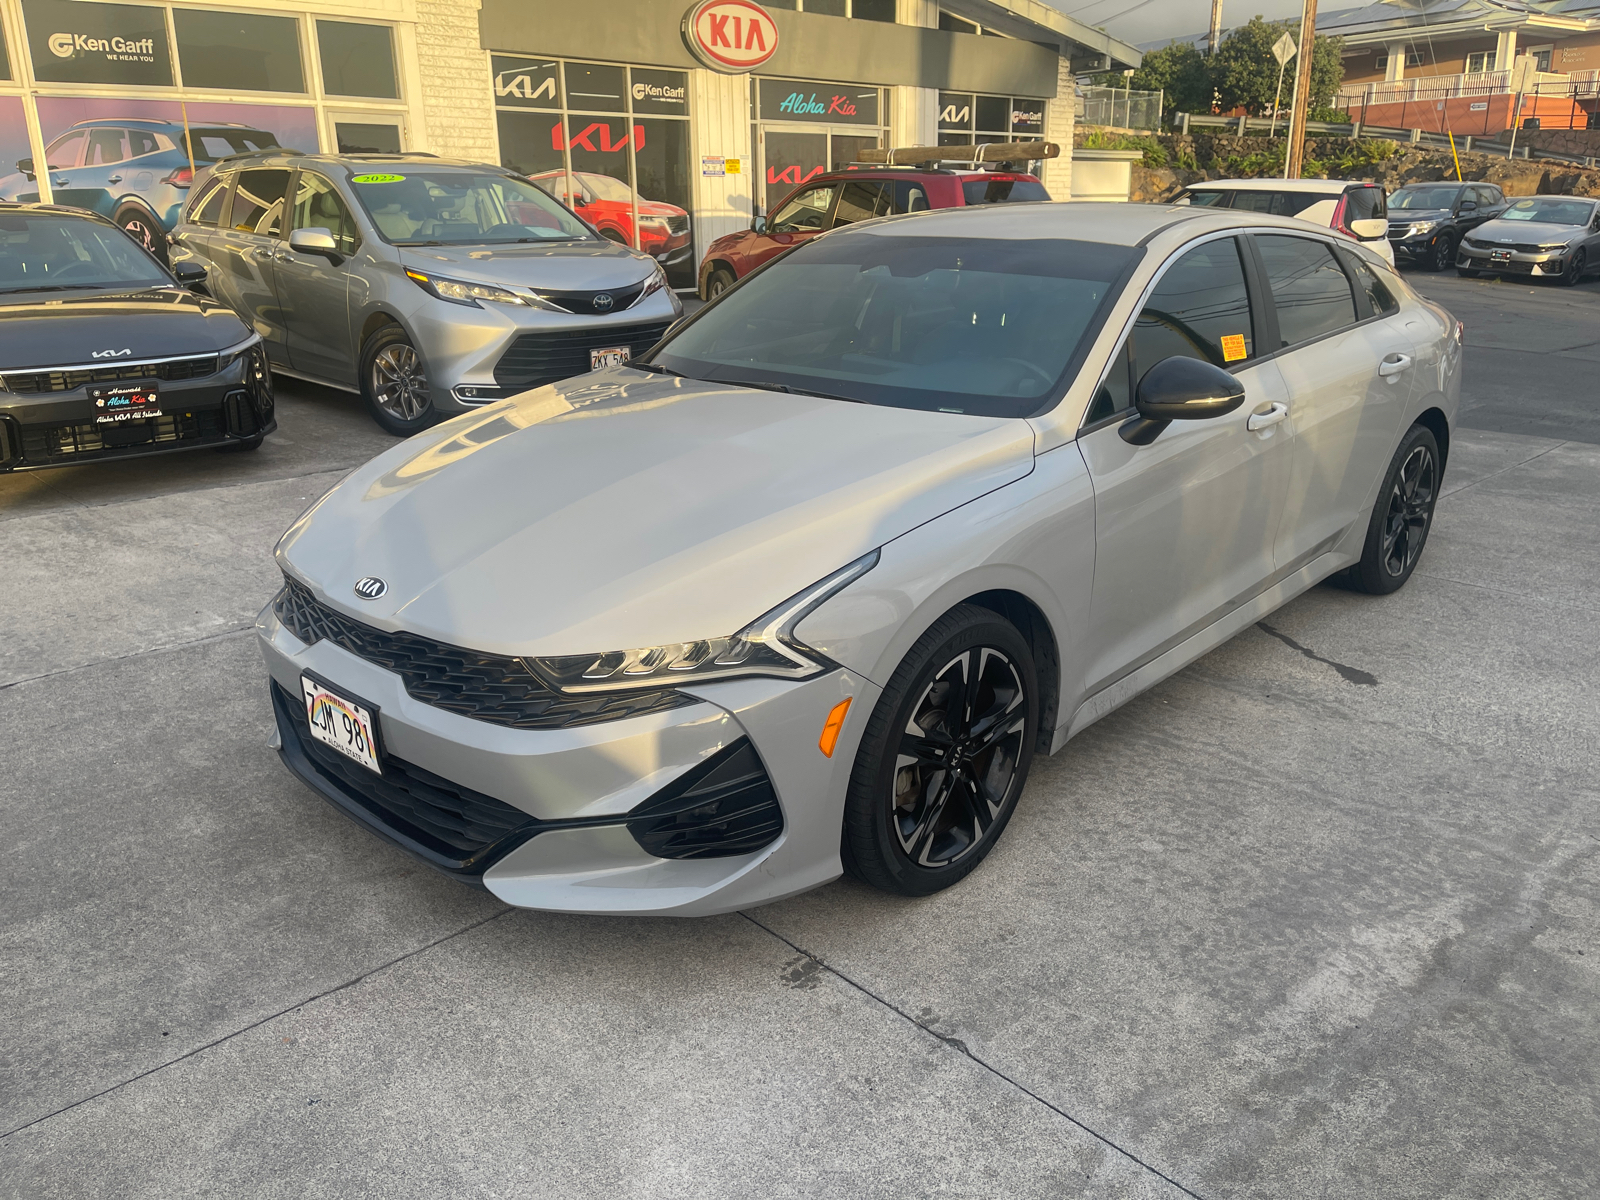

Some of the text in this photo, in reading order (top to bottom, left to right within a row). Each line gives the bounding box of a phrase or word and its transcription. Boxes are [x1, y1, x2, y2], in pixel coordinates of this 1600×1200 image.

[708, 13, 766, 52] KIA
[73, 33, 153, 54] Ken Garff
[645, 84, 684, 98] Ken Garff
[780, 92, 857, 116] Aloha Kia
[592, 355, 608, 369] ZKX
[107, 394, 146, 406] Aloha Kia
[132, 411, 141, 419] All
[142, 409, 162, 418] Islands
[356, 577, 381, 597] KIA
[306, 691, 372, 759] ZJM 981
[328, 737, 363, 763] ALOHA STATE
